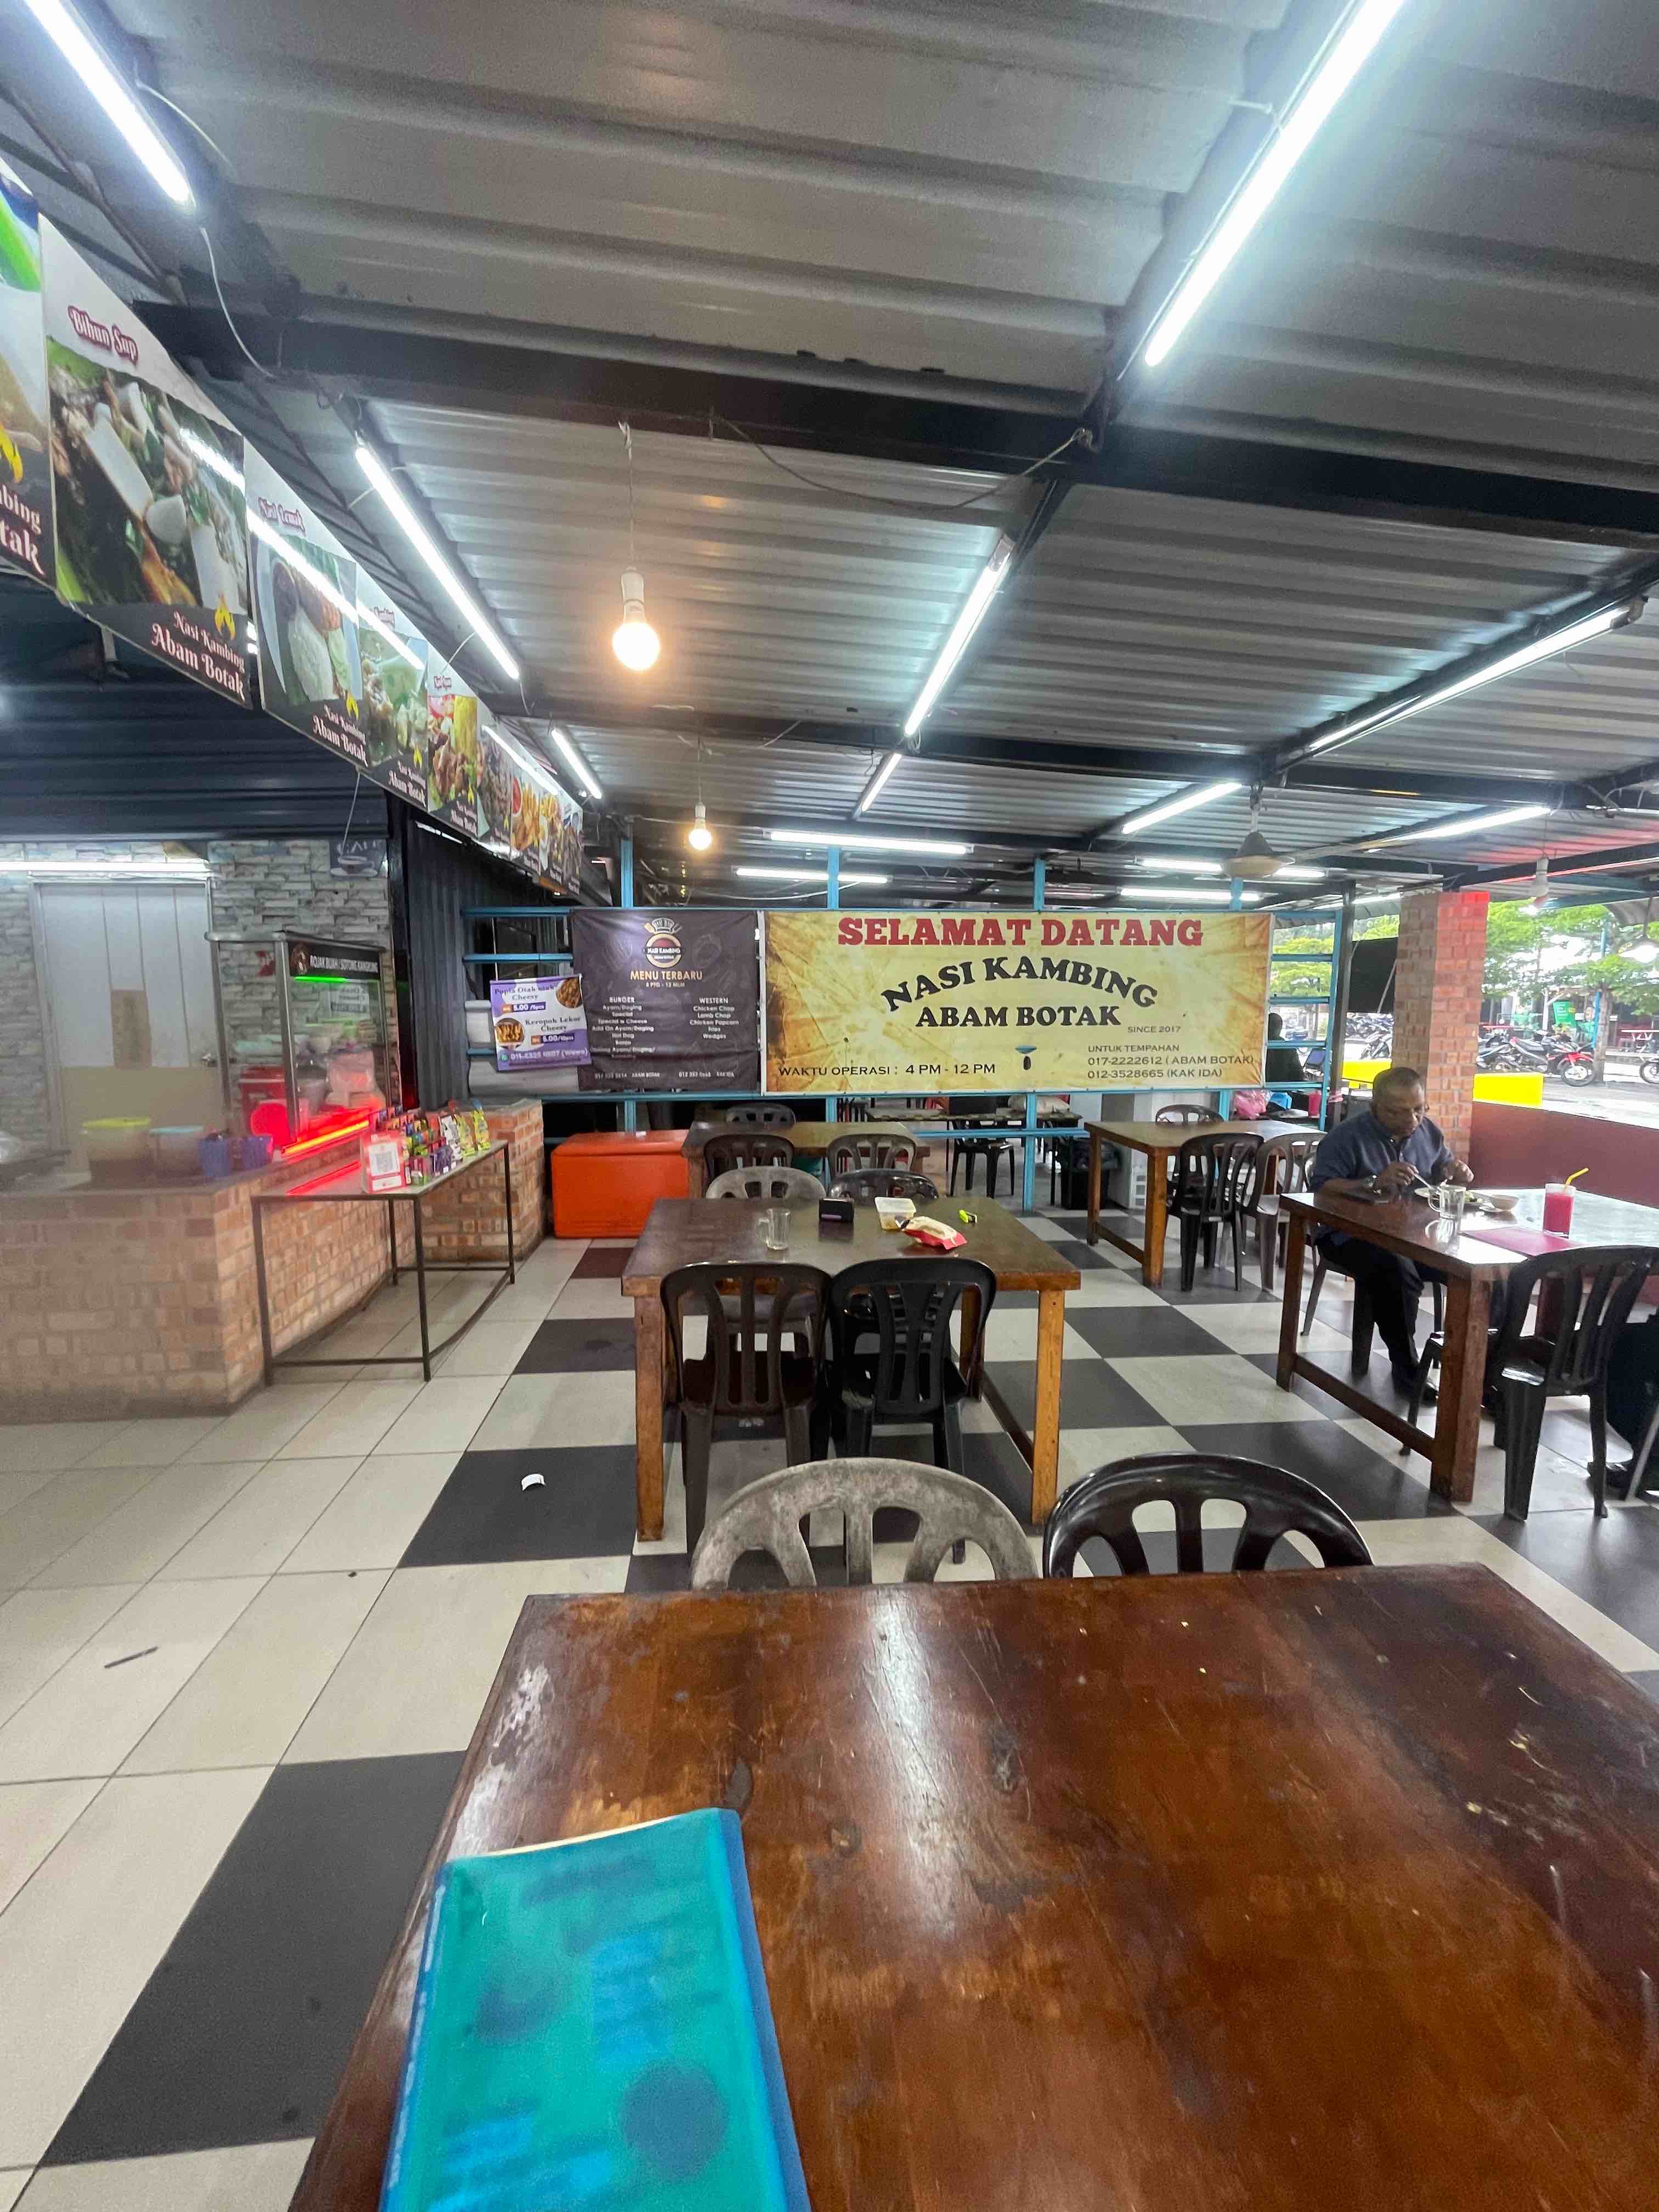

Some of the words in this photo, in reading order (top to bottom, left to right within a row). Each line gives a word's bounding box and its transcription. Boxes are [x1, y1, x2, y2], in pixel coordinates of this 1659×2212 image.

[112, 324, 138, 364] Sup
[151, 623, 199, 671] Abam
[201, 653, 245, 701] Botak
[201, 629, 245, 674] Kambing
[313, 715, 340, 747] Abam
[341, 733, 368, 767] Botak
[838, 917, 1031, 945] SELAMAT
[1041, 919, 1203, 946] DATANG
[630, 970, 659, 980] MENU
[661, 970, 702, 980] TERBARU
[881, 961, 975, 1012] NASI
[983, 956, 1158, 1007] KAMBING
[916, 1007, 1008, 1026] ABAM
[1015, 1006, 1121, 1026] BOTAK
[779, 1066, 827, 1076] WAKTU
[831, 1066, 890, 1075] OPERASI
[905, 1064, 915, 1074] 4
[919, 1064, 941, 1074] PM
[953, 1064, 969, 1074] 12
[973, 1064, 996, 1074] PM
[1088, 1057, 1163, 1065] 017-2222612
[1172, 1056, 1207, 1065] ABAM
[1210, 1056, 1254, 1064] BOTAK)
[1088, 1070, 1164, 1079] 012-3528665
[1167, 1069, 1195, 1078] (KAK
[1198, 1069, 1222, 1077] IDA)
